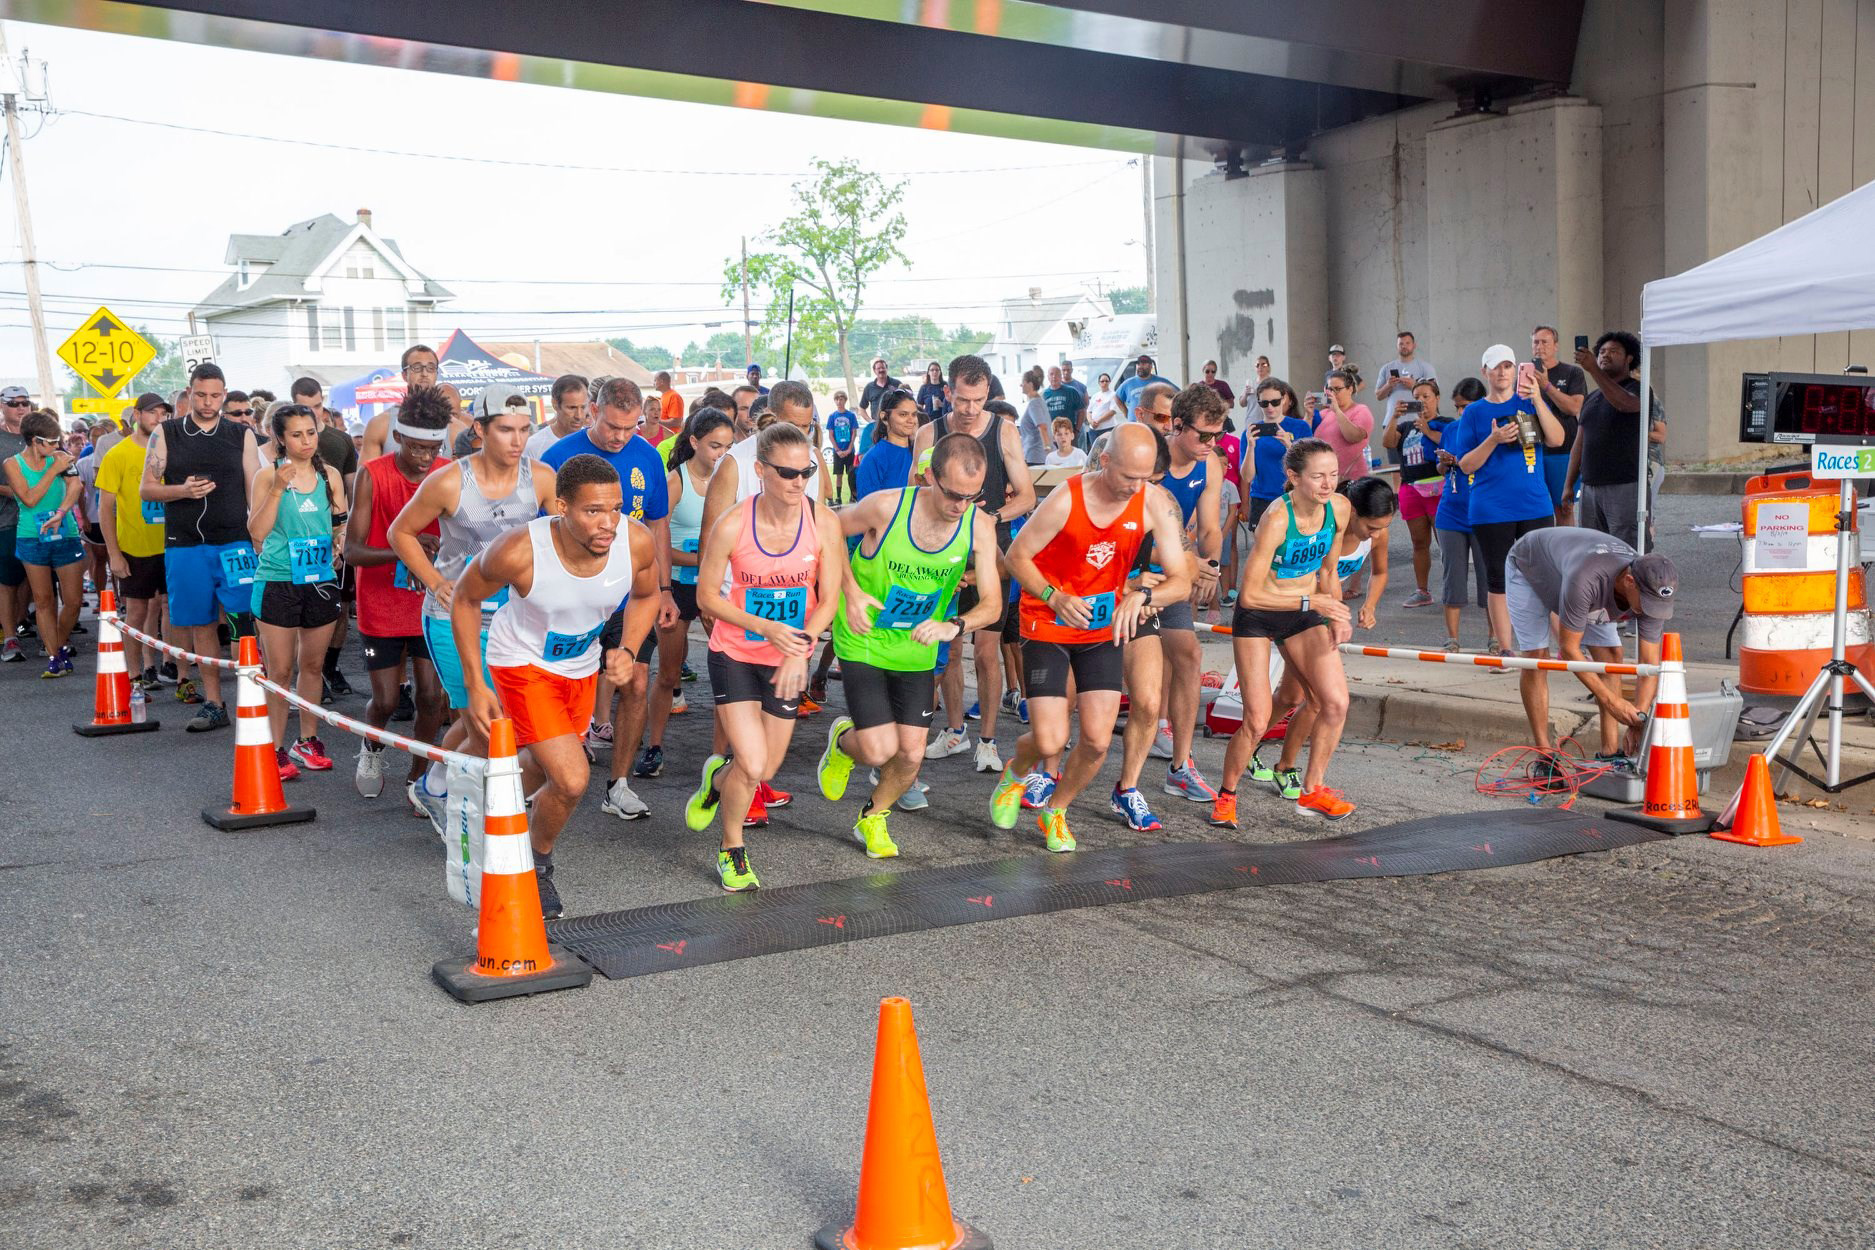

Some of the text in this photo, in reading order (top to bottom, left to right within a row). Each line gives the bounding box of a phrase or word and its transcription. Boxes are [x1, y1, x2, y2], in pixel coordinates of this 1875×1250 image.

[183, 338, 211, 347] SPEED
[187, 348, 208, 356] LIMIT
[532, 384, 553, 393] SYST
[1817, 452, 1872, 470] Races 2
[296, 546, 327, 566] 7172
[1291, 542, 1325, 565] 6899
[227, 556, 257, 572] 7181
[752, 591, 774, 599] Races
[753, 599, 799, 621] 7219
[891, 597, 934, 616] 7218
[95, 711, 128, 719] un.com
[477, 952, 537, 971] un.com
